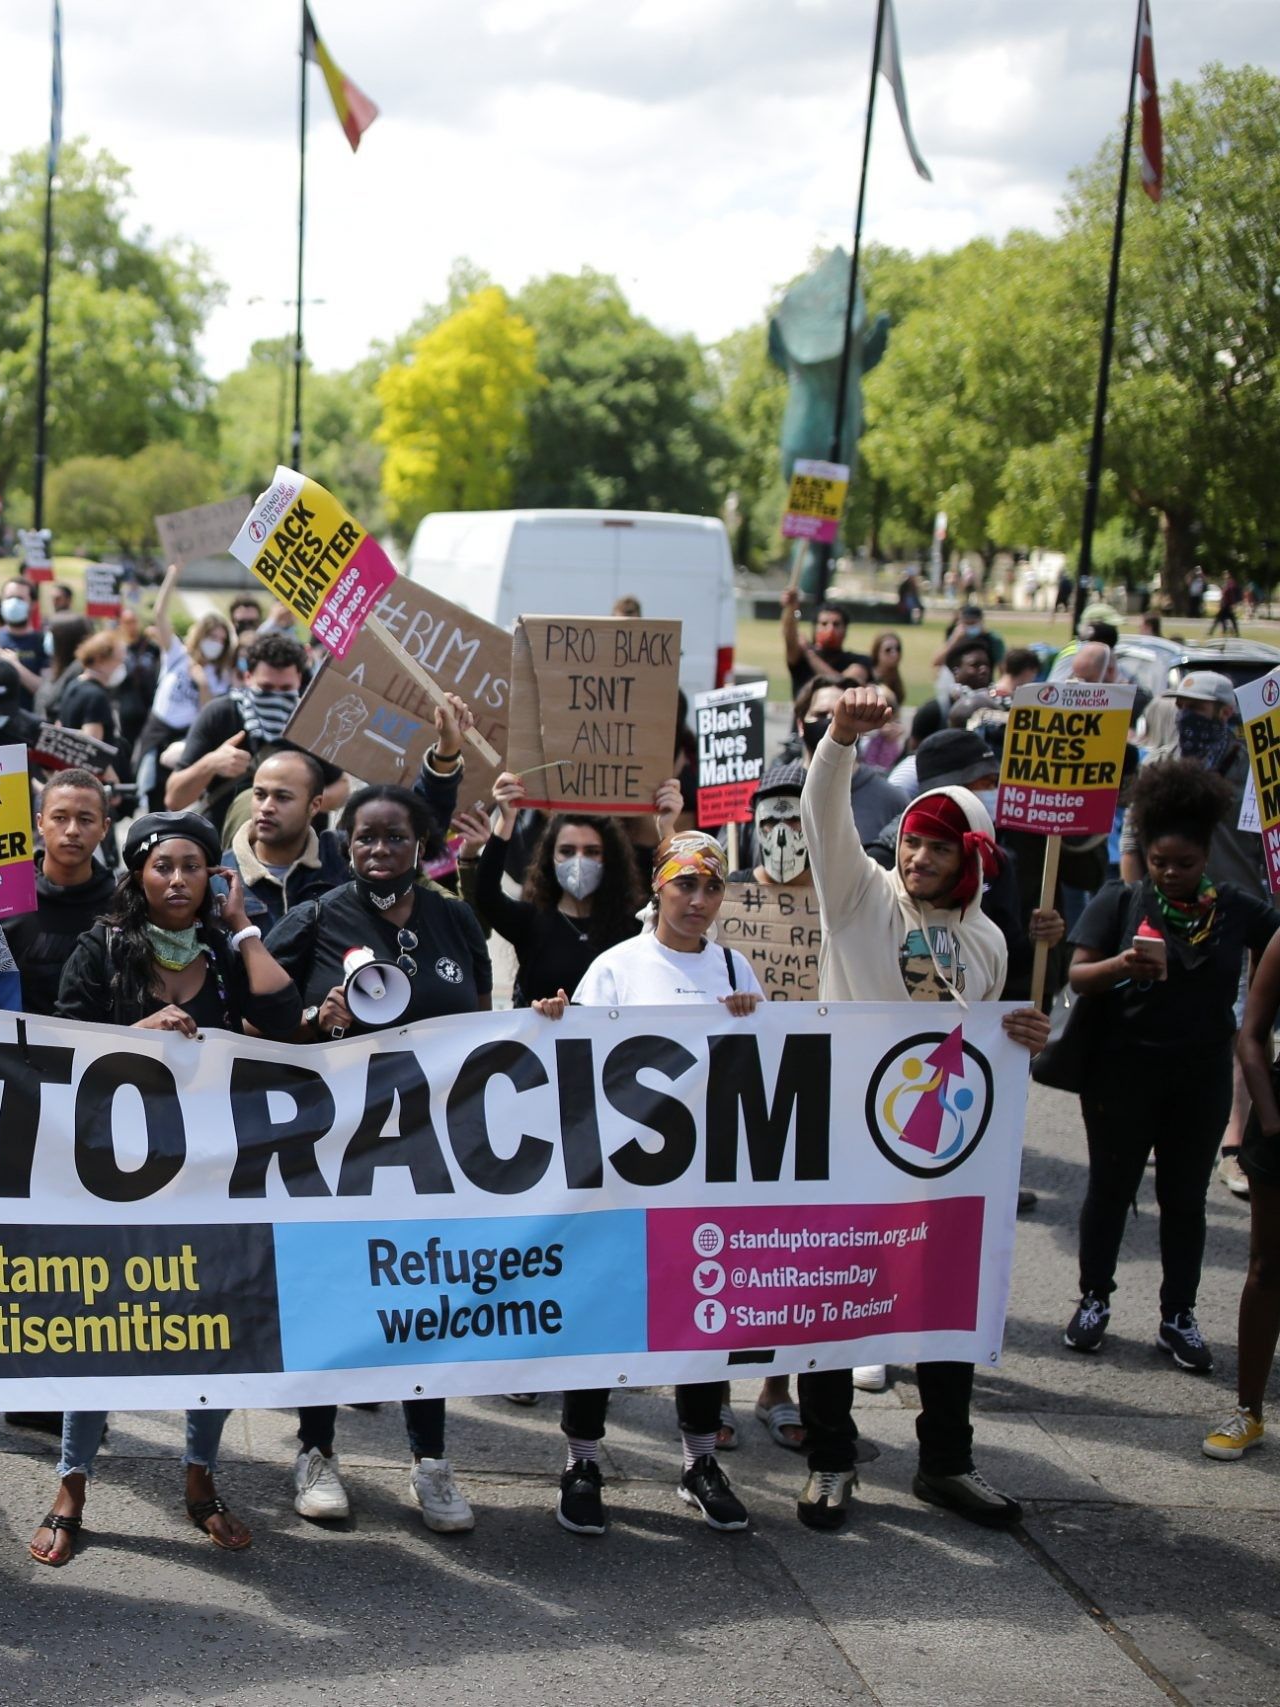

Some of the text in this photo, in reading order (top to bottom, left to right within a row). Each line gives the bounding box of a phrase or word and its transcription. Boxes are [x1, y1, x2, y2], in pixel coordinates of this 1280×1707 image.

[260, 494, 279, 519] STAND
[267, 514, 277, 526] TO
[256, 499, 315, 583] BLACK
[274, 530, 323, 601] LIVES
[292, 521, 360, 619] MATTER
[314, 567, 360, 636] No justice
[325, 626, 342, 647] No
[340, 586, 366, 629] peace
[375, 593, 480, 684] #BLM
[474, 672, 508, 708] IS
[546, 624, 673, 667] PRO BLACK
[568, 675, 635, 713] ISN'T
[1062, 690, 1105, 698] STAND UP
[1062, 698, 1109, 706] TO RACISM
[698, 702, 752, 736] Black
[1013, 709, 1103, 736] BLACK
[41, 728, 97, 756] Black
[571, 720, 636, 756] ANTI
[698, 734, 747, 761] Lives
[1010, 734, 1085, 760] LIVES
[558, 762, 643, 798] WHITE
[699, 756, 763, 787] Matter
[1007, 758, 1116, 784] MATTER
[1004, 787, 1084, 807] No justice
[1002, 803, 1075, 823] No peace
[724, 918, 773, 940] ONE
[765, 968, 819, 990] RAC
[227, 1033, 832, 1200] RACISM
[729, 1221, 929, 1253] standuptoracism.org.uk
[124, 1244, 199, 1293] out
[366, 1237, 563, 1295] Refugees
[731, 1265, 877, 1289] @AntiRacismDay
[376, 1295, 563, 1345] welcome
[793, 1305, 816, 1327] Up
[821, 1302, 838, 1322] To
